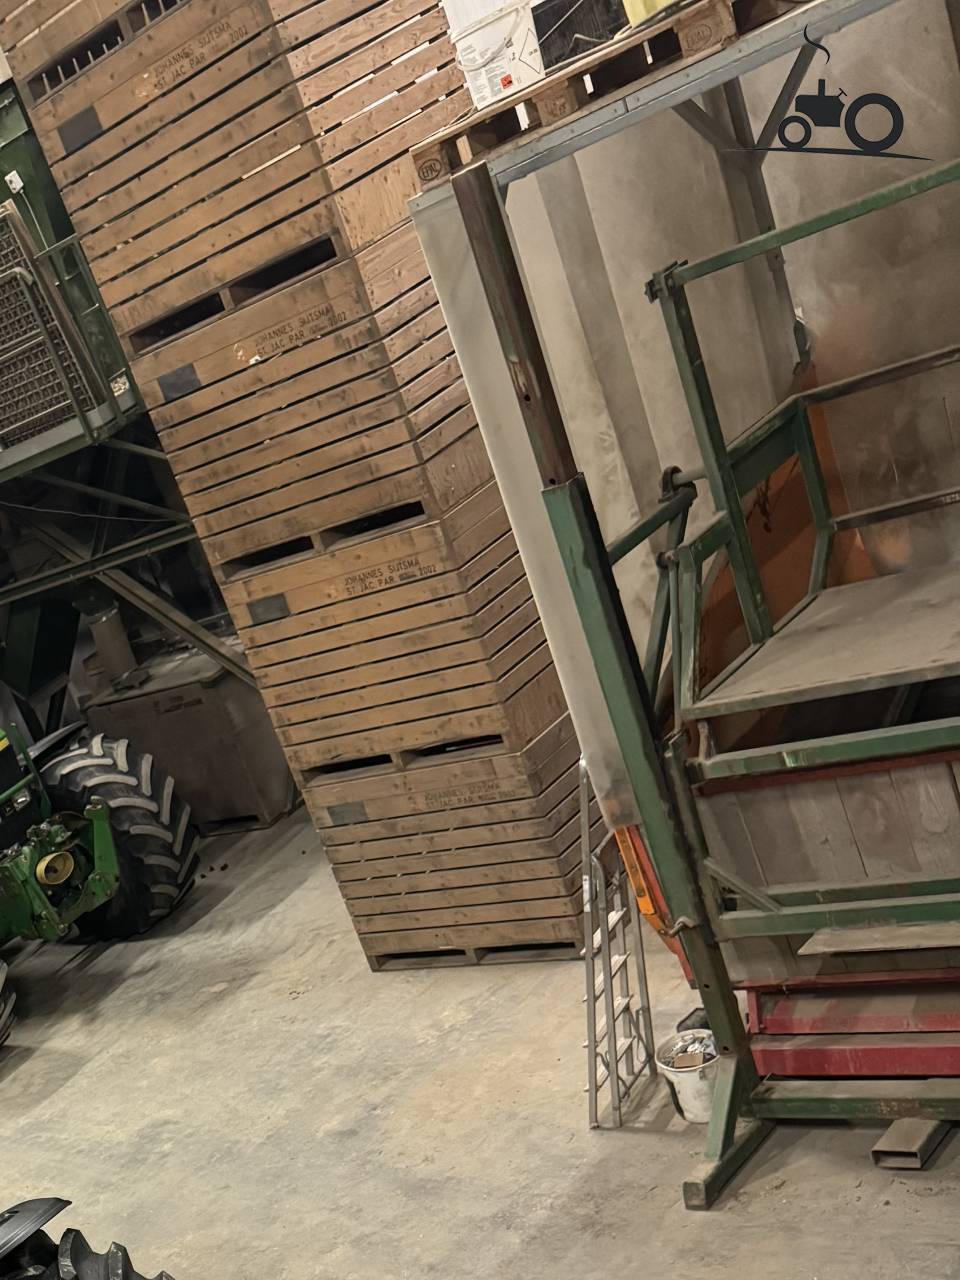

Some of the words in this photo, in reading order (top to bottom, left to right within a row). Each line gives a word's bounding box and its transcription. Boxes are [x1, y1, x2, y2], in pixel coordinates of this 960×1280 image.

[172, 65, 186, 81] JAC
[189, 52, 207, 68] PAR
[230, 25, 249, 43] 2002
[289, 331, 305, 343] PAR
[378, 576, 395, 587] PAR
